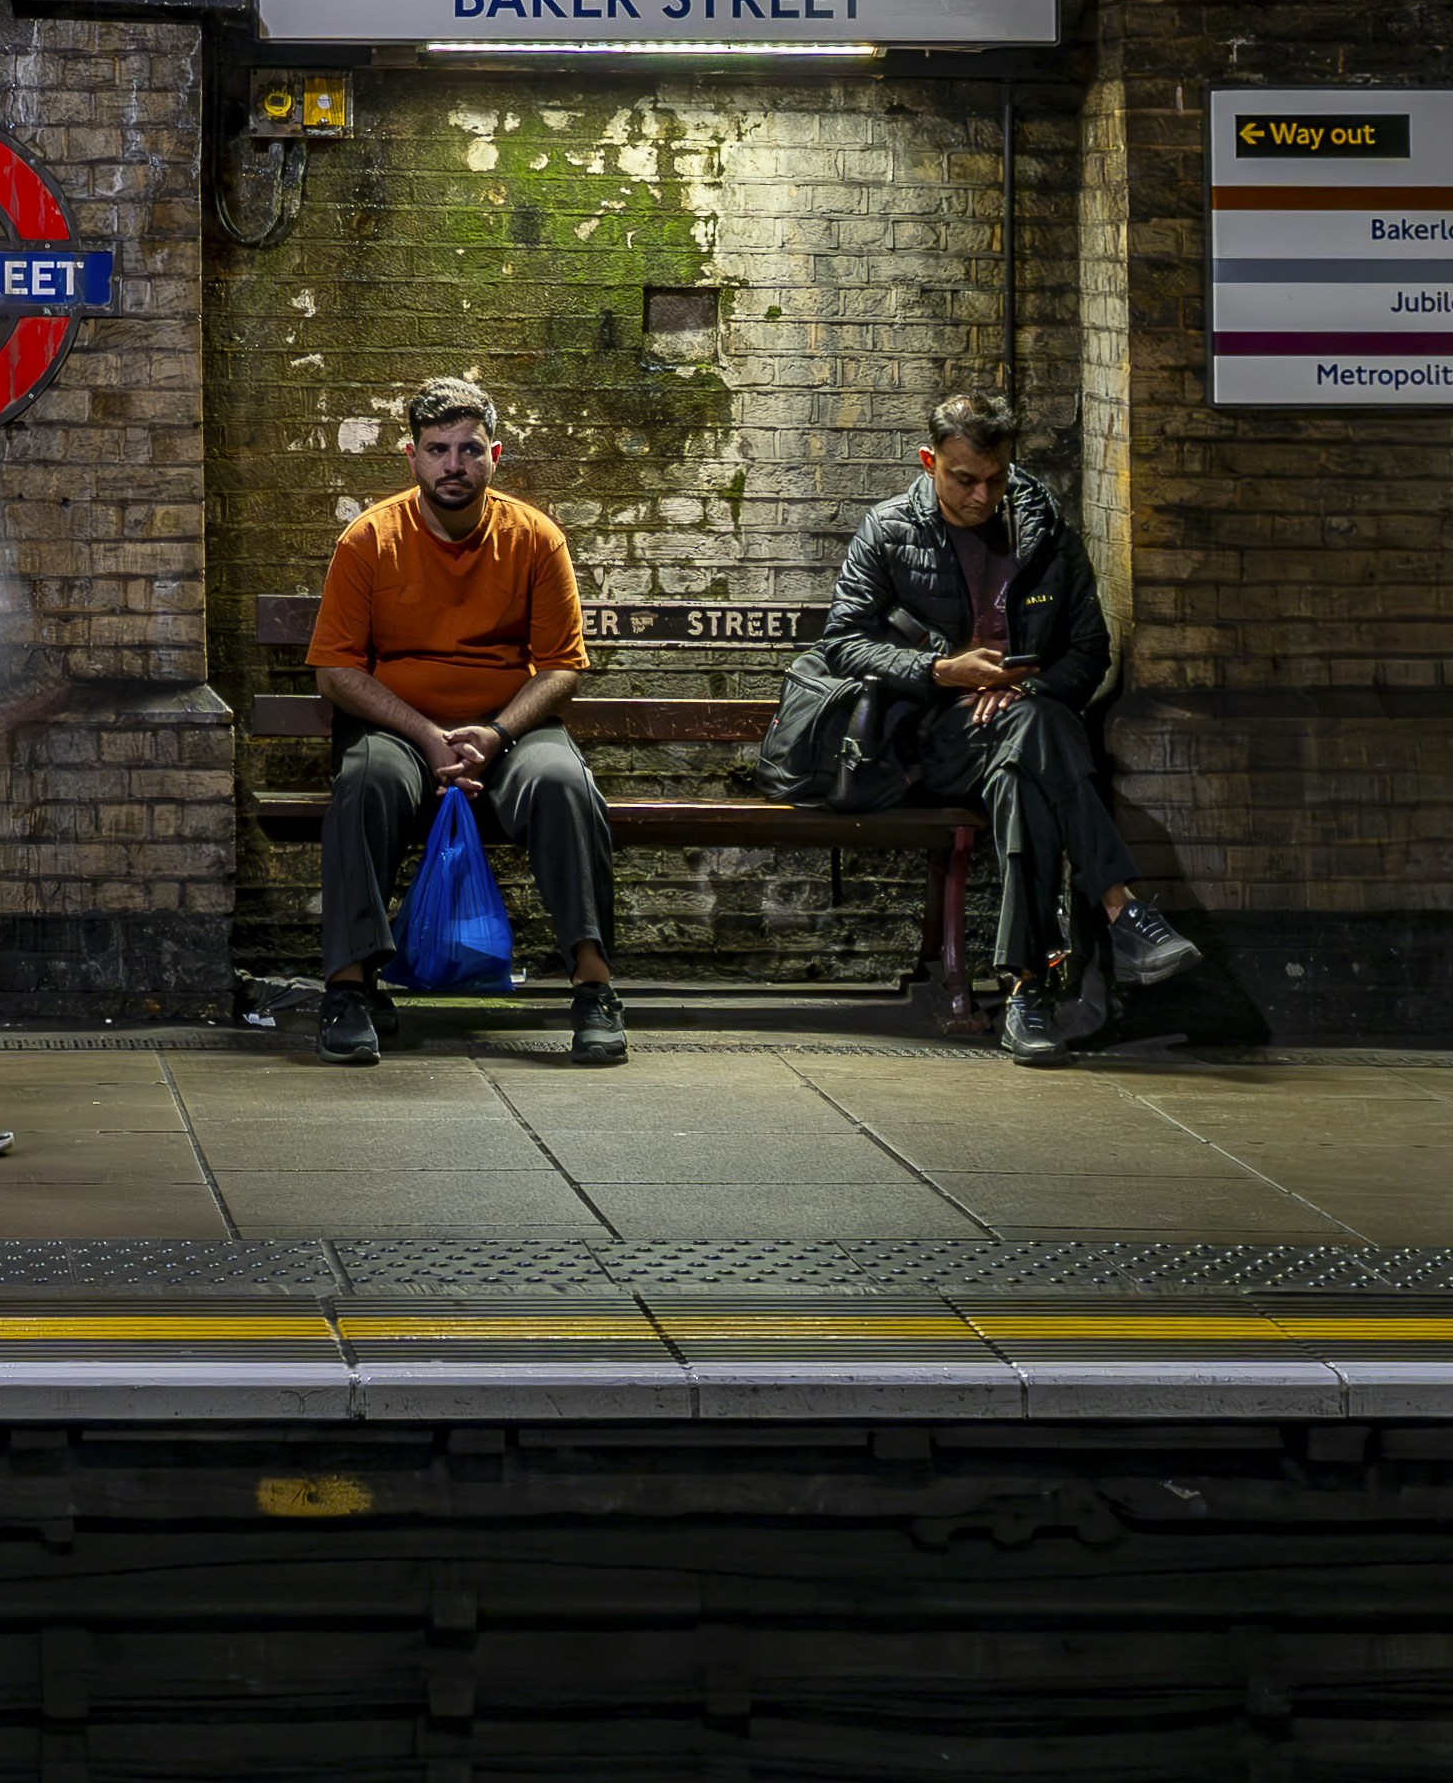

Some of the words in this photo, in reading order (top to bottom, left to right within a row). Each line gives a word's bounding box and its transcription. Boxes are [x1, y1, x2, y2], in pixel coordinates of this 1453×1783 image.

[1269, 122, 1324, 150] Way
[1331, 125, 1375, 145] out
[687, 611, 801, 637] STREET
